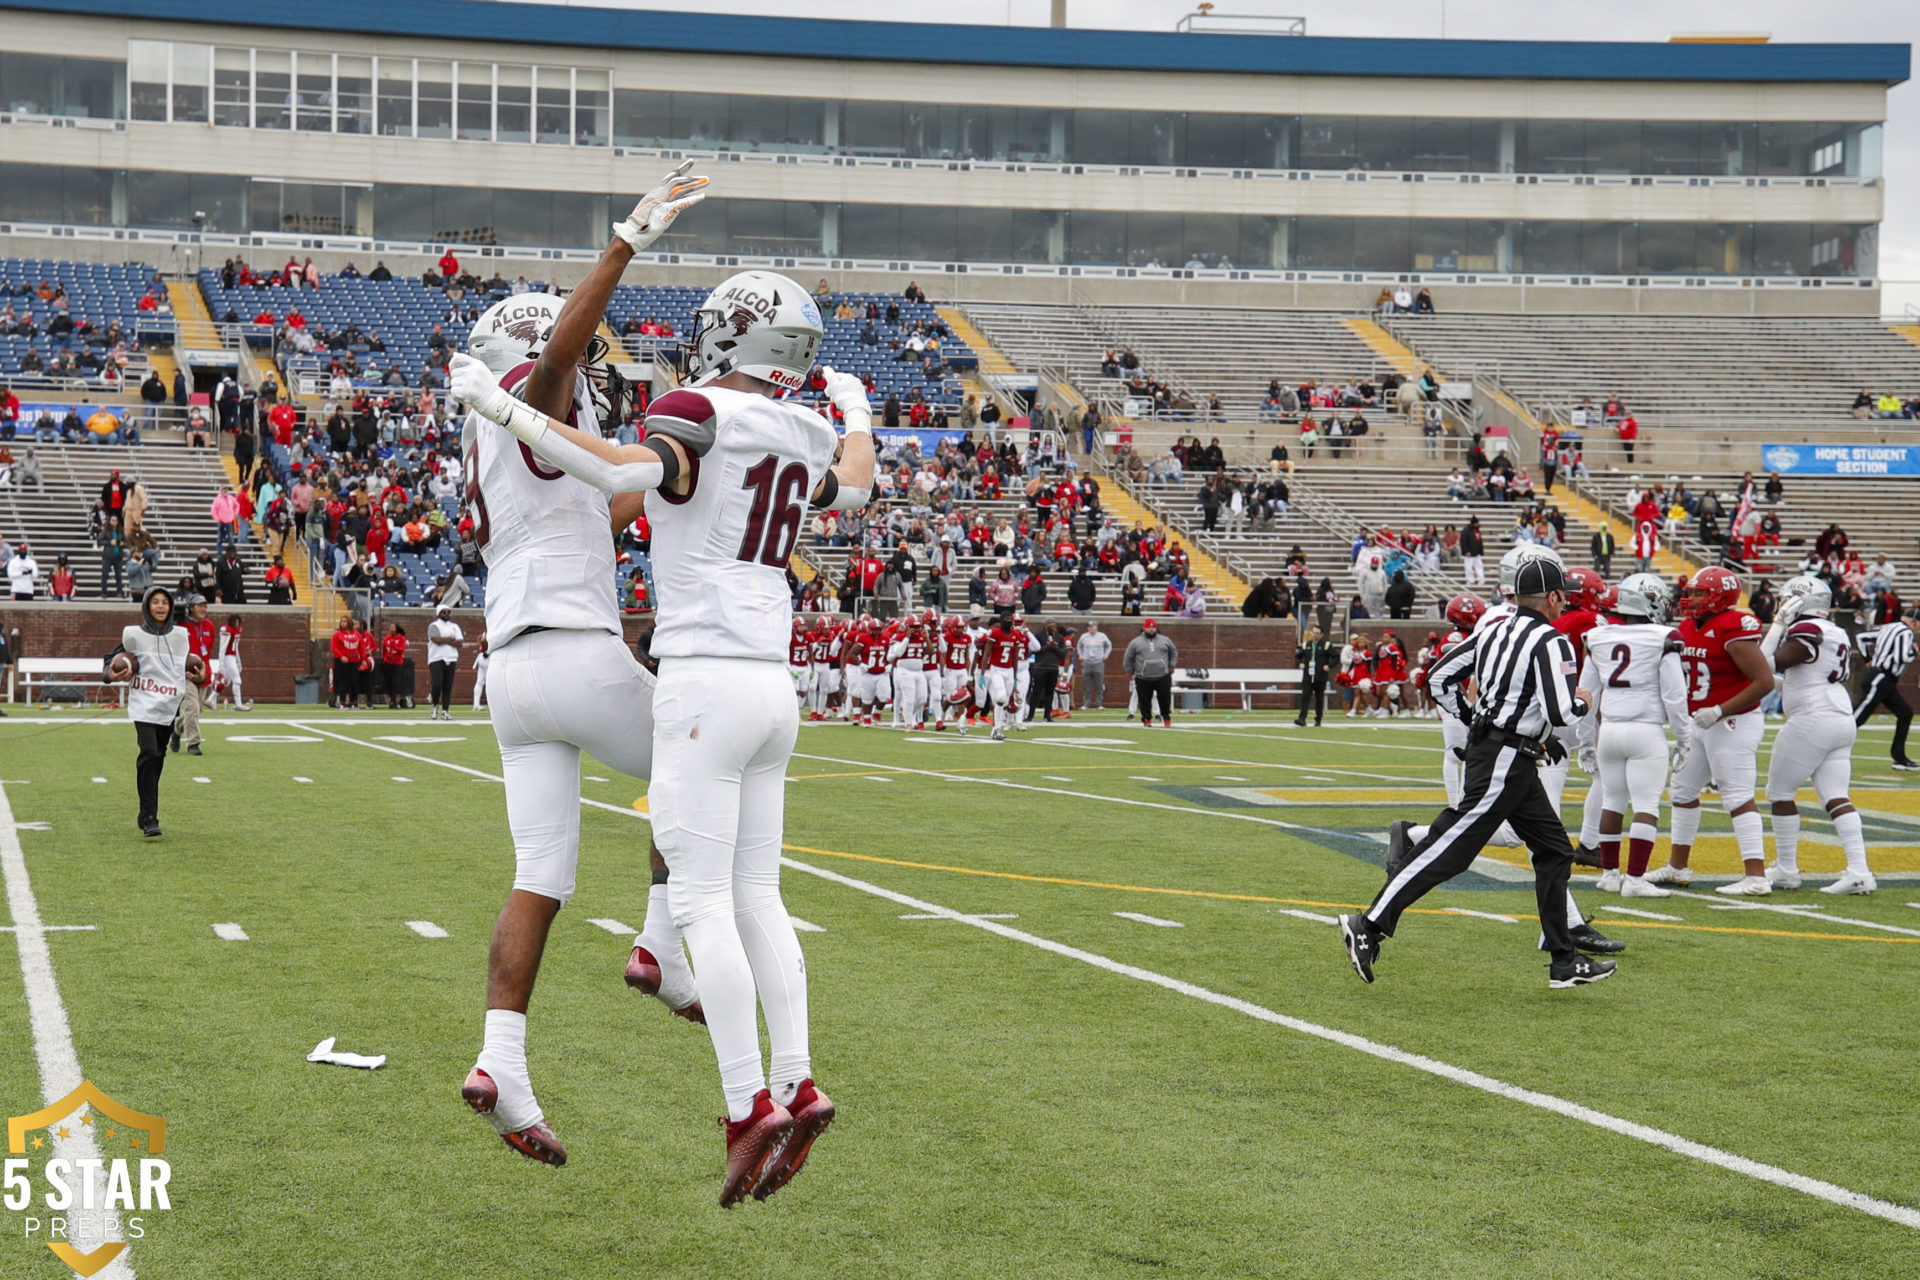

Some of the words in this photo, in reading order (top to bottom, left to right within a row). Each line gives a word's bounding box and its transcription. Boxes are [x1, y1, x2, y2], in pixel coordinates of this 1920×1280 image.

[722, 287, 778, 326] ALCOA
[492, 306, 553, 333] ALCOA
[1815, 447, 1849, 460] HOME
[1852, 448, 1908, 461] STUDENT
[1836, 461, 1888, 473] SECTION
[736, 452, 809, 569] 16
[1721, 575, 1739, 591] 53
[815, 645, 828, 660] 21
[868, 651, 886, 668] 62
[1000, 646, 1011, 663] 5
[1608, 643, 1632, 688] 2
